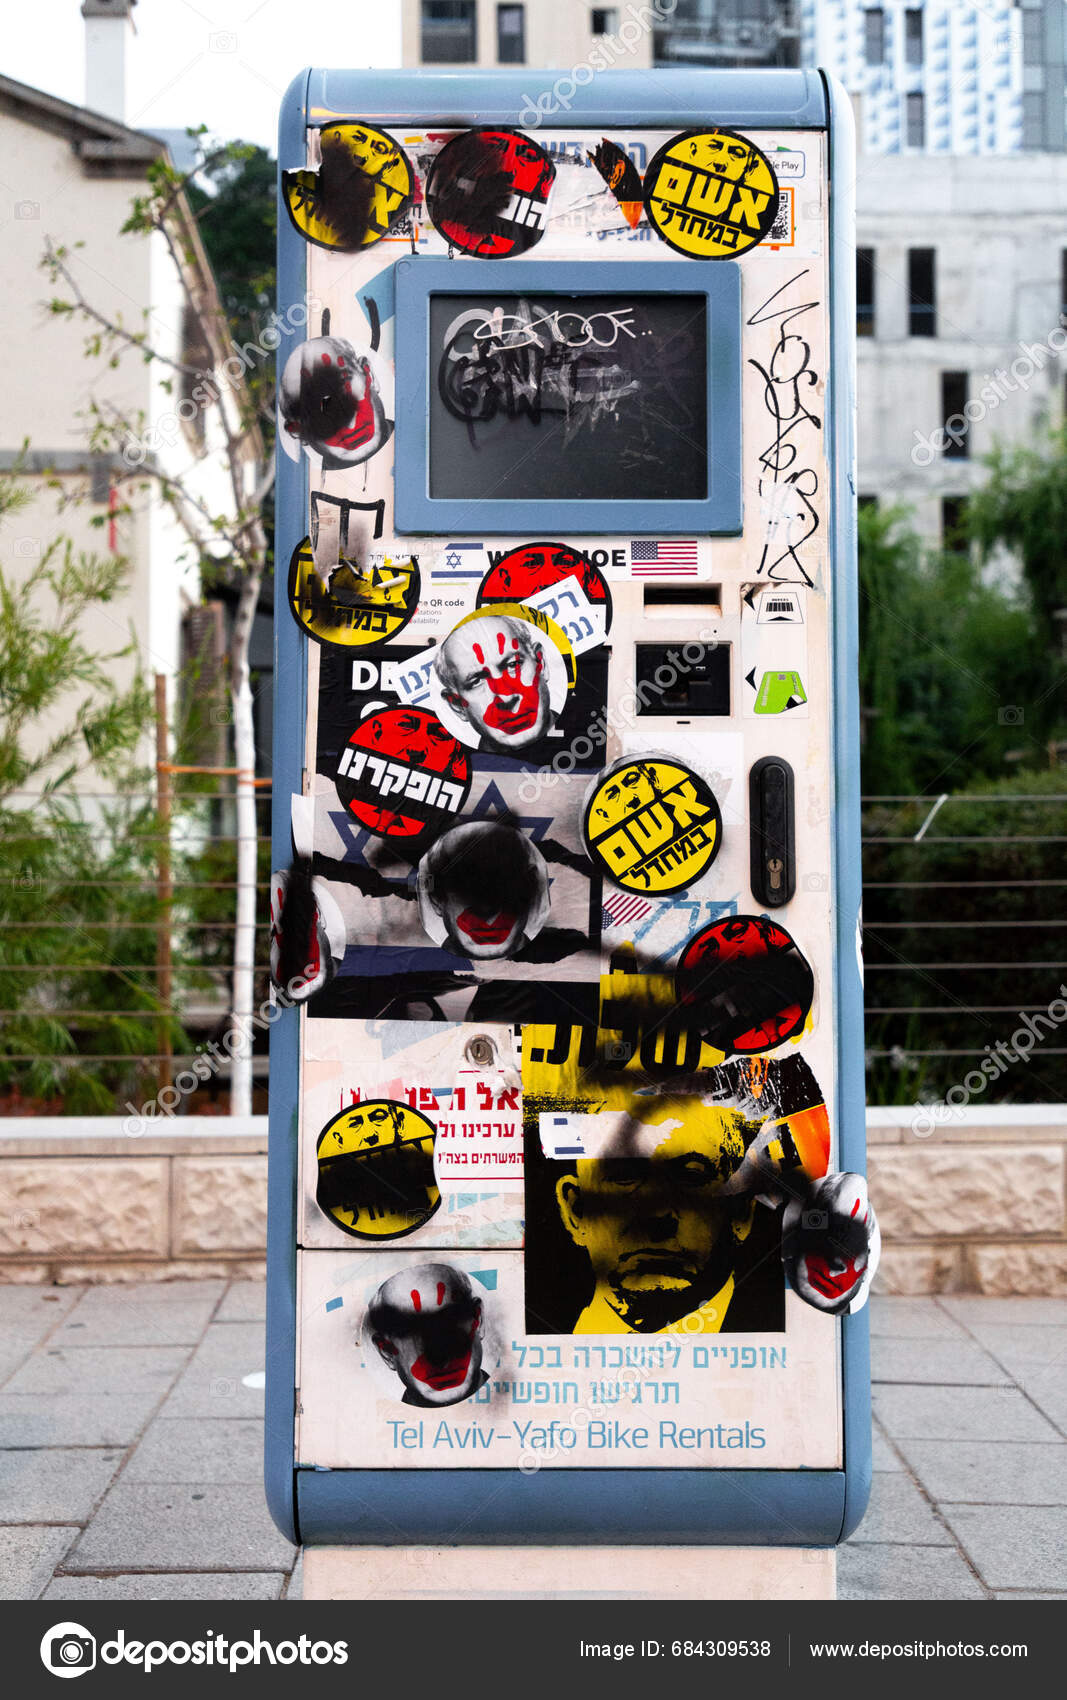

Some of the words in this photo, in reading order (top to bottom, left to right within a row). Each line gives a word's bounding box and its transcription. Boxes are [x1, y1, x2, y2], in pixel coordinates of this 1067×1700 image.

[781, 161, 799, 171] Play
[652, 162, 770, 230] אשם
[660, 202, 741, 249] במחדל
[430, 599, 443, 607] QR
[444, 599, 465, 607] code
[337, 748, 465, 813] הופקרנו
[596, 780, 711, 878] אשם
[629, 825, 713, 888] במחדל
[462, 1123, 515, 1138] ערכינו
[511, 1340, 563, 1369] בכל
[573, 1340, 682, 1369] להשכרה
[693, 1346, 787, 1369] אופניים
[590, 1381, 680, 1404] תרגישו
[386, 1420, 424, 1449] Tel
[587, 1420, 649, 1449] Bike
[659, 1420, 766, 1449] Rentals
